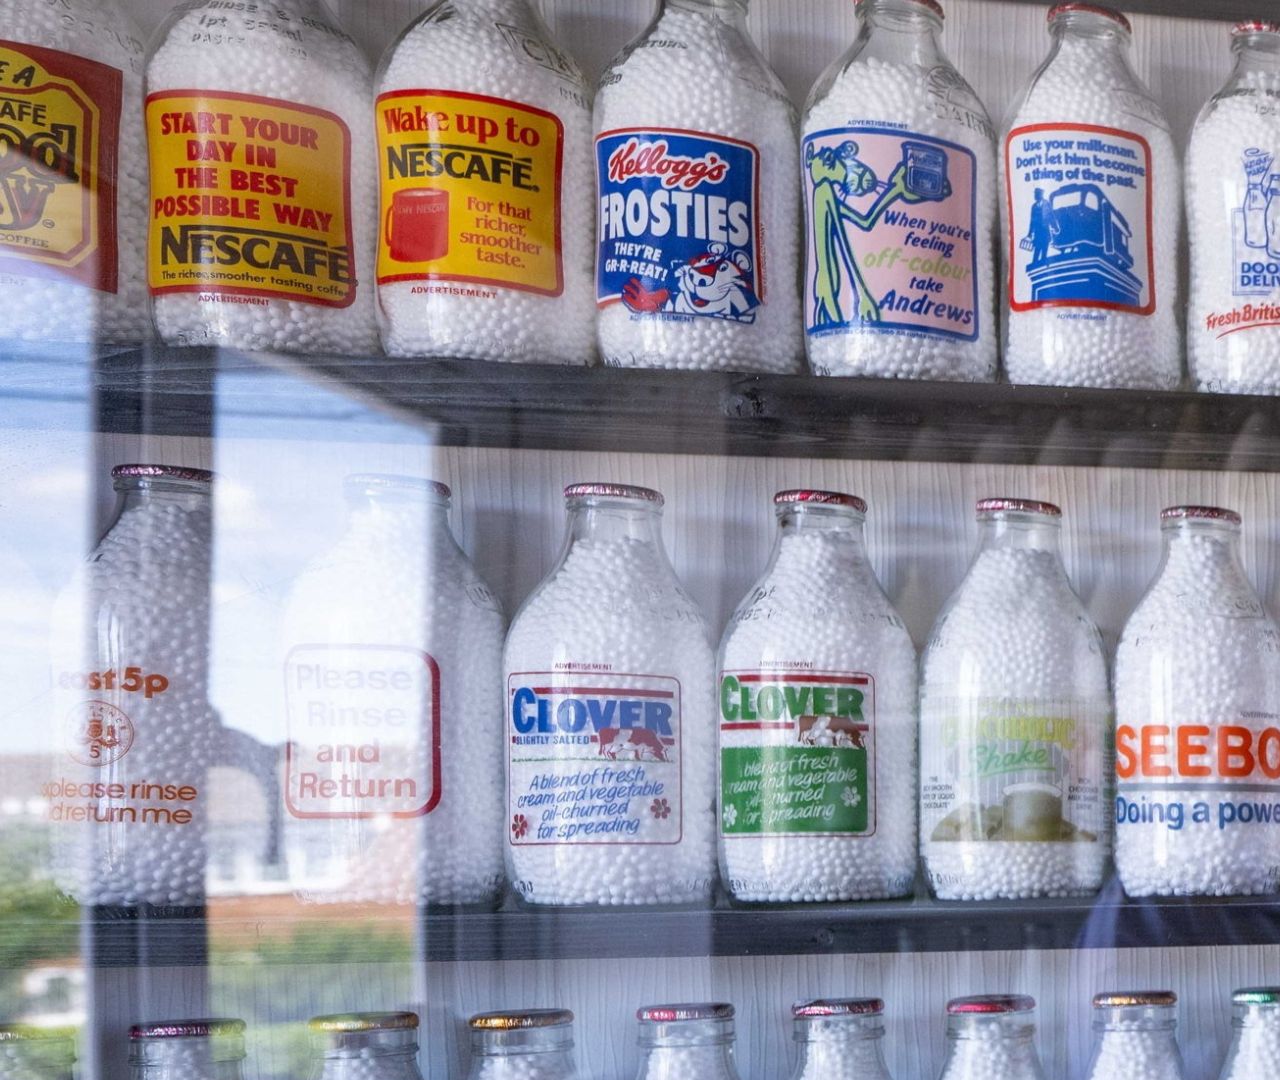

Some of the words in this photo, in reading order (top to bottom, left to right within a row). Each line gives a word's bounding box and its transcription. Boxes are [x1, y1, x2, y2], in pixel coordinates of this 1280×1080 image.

[13, 66, 37, 87] A
[161, 112, 233, 136] START
[240, 117, 319, 150] YOUR
[384, 106, 451, 136] Wake
[455, 113, 500, 144] up
[504, 116, 541, 149] to
[187, 140, 237, 163] DAY
[244, 145, 277, 168] IN
[607, 139, 730, 189] Kellogg's
[1022, 139, 1043, 155] Use
[1044, 140, 1074, 156] your
[1075, 139, 1138, 161] milkman.
[174, 167, 219, 190] THE
[230, 172, 299, 205] BEST
[467, 196, 495, 213] For
[497, 201, 532, 221] that
[600, 188, 750, 248] FROSTIES
[904, 230, 956, 260] feeling
[410, 286, 499, 301] ADVERTISEMENT
[908, 275, 945, 295] take
[878, 288, 974, 325] Andrews
[511, 686, 674, 738] CLOVER
[720, 674, 866, 722] CLOVER
[315, 738, 381, 764] and
[969, 737, 1050, 770] Shake
[299, 772, 418, 800] Return
[517, 790, 556, 810] cream
[556, 786, 587, 805] and
[588, 777, 664, 803] vegetable
[64, 804, 137, 824] return
[141, 805, 193, 824] me
[1115, 795, 1186, 832] Doing
[1191, 801, 1213, 825] a
